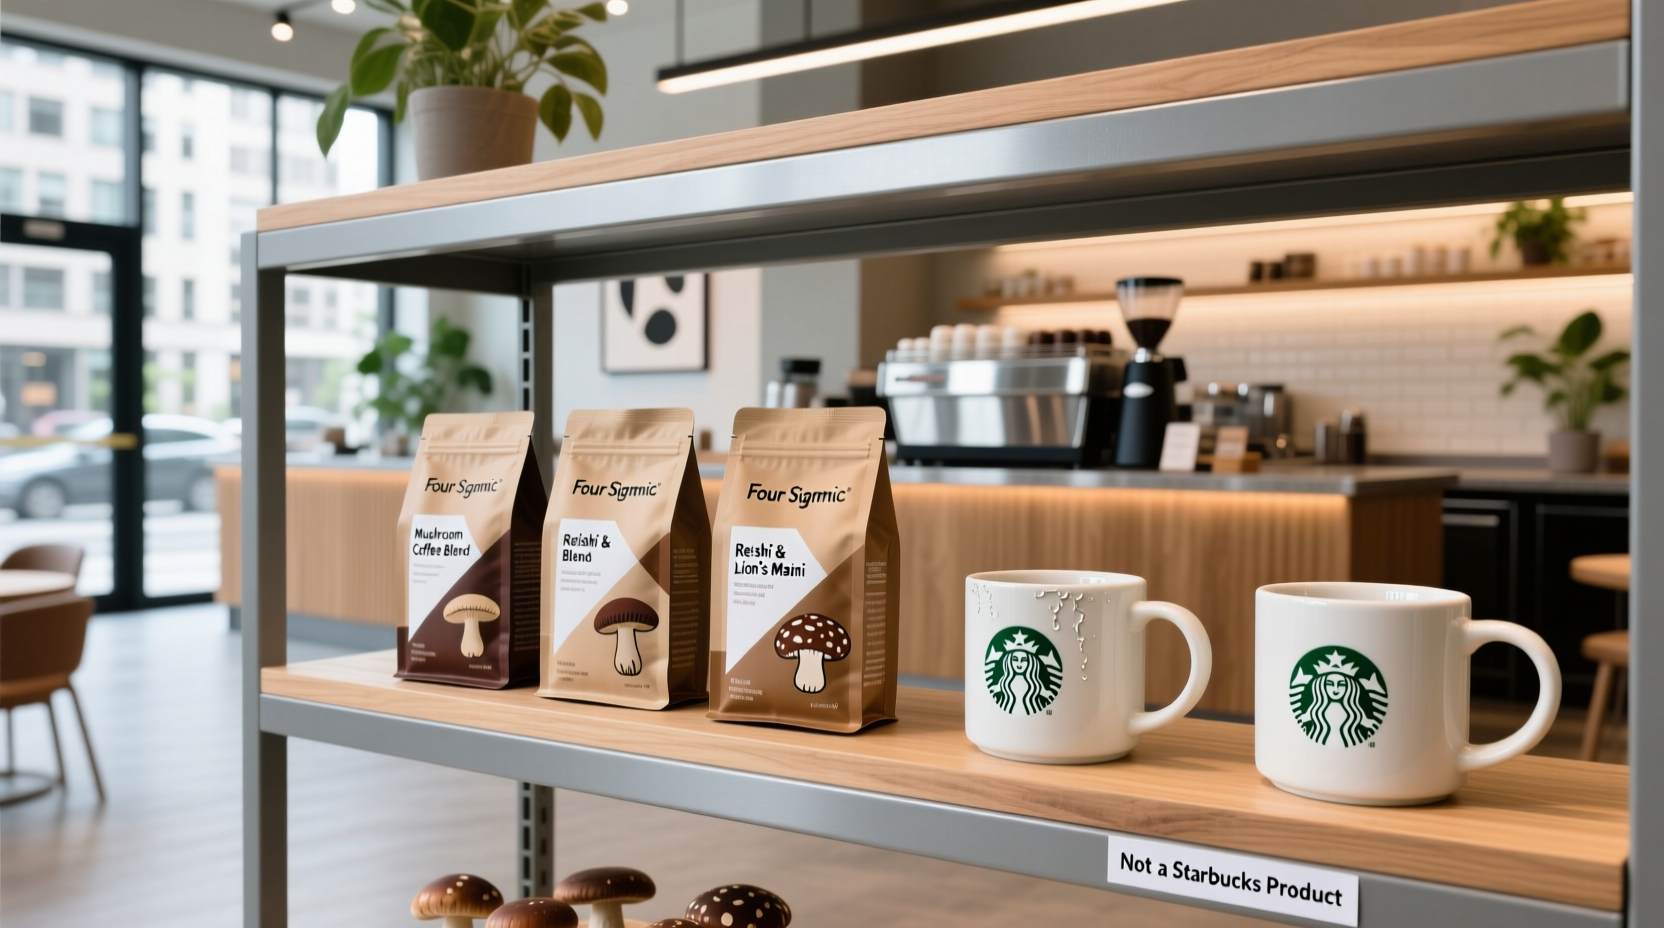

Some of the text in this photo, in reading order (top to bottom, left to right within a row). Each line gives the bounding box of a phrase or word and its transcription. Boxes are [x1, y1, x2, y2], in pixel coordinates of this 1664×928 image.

[424, 477, 456, 493] Four
[572, 479, 607, 496] Four
[747, 483, 786, 503] Four
[601, 534, 611, 549] &
[562, 548, 592, 563] Blend
[775, 544, 786, 559] &
[1120, 851, 1343, 907] Not a Starbucks Product
